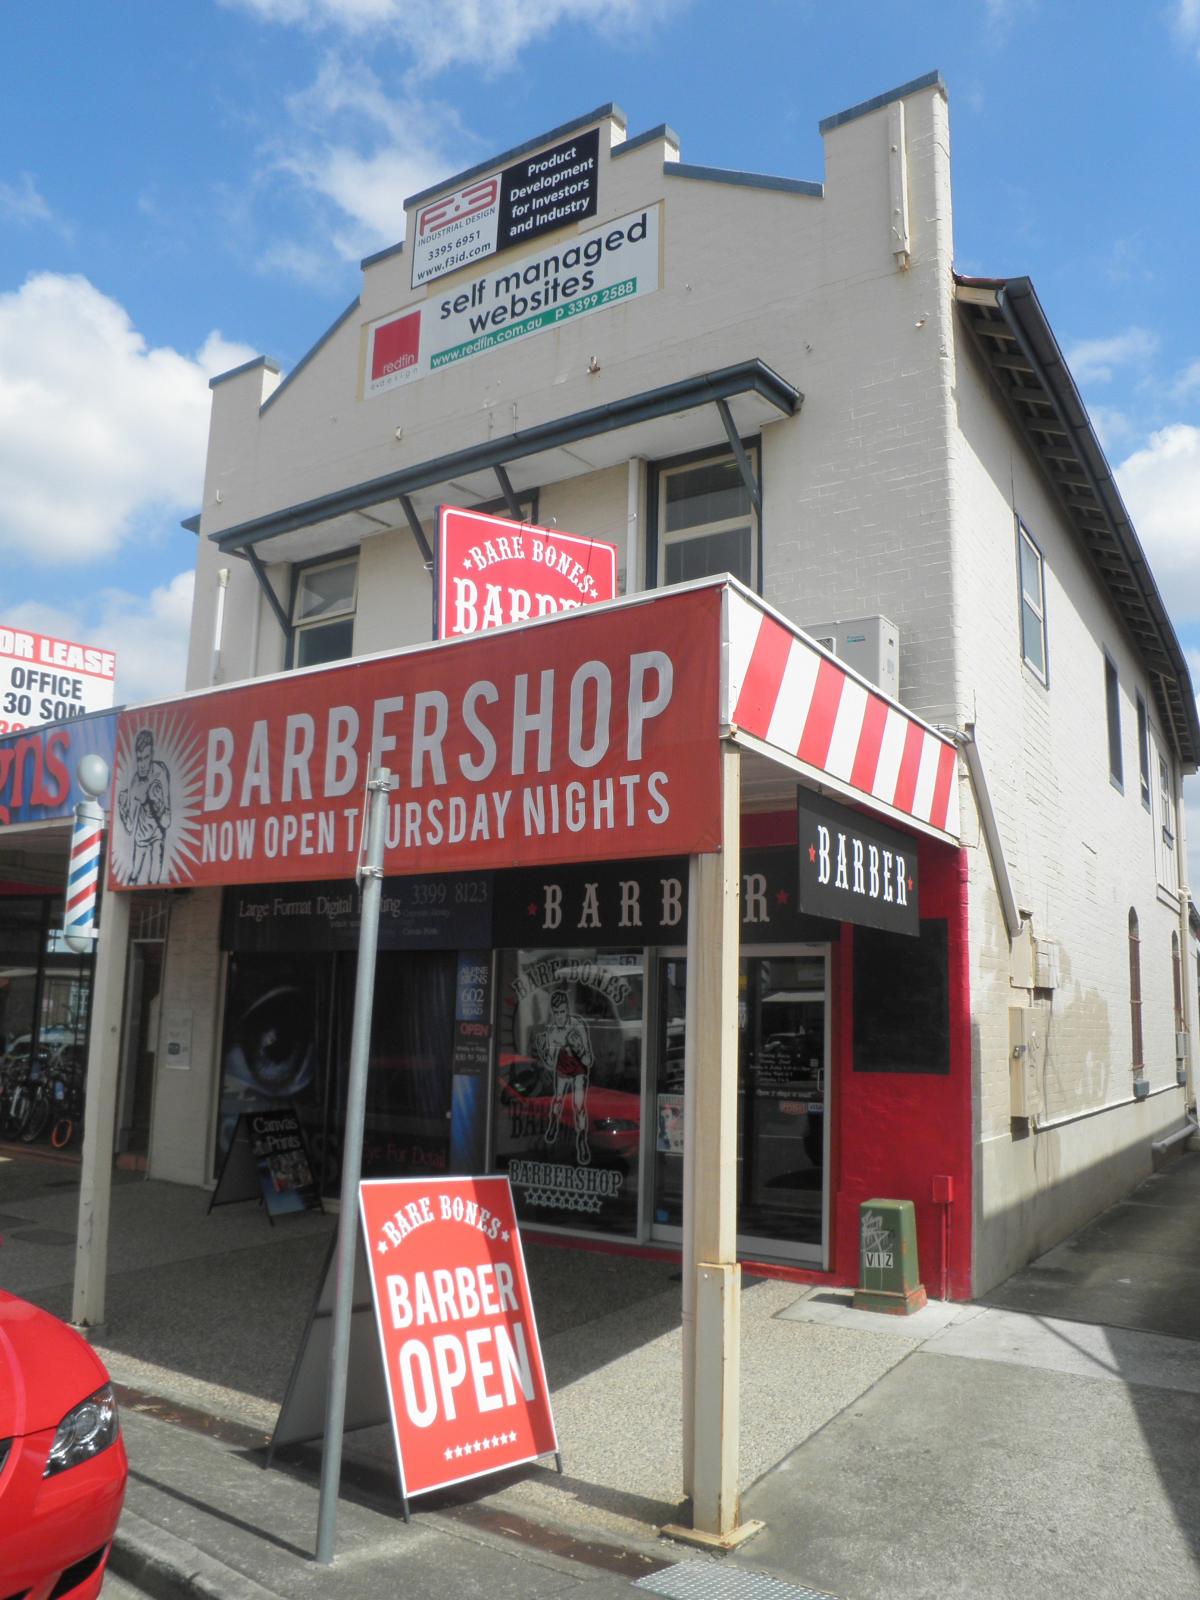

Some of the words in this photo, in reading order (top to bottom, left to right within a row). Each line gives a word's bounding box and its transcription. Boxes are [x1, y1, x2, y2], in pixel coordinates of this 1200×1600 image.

[510, 157, 594, 202] Development
[527, 147, 577, 177] Product
[509, 216, 533, 237] and
[536, 196, 591, 226] Industry
[512, 203, 530, 218] for
[532, 179, 590, 210] Investors
[417, 221, 463, 248] INDUSTRIAL
[465, 207, 496, 226] DESIGN
[428, 242, 453, 261] 3395
[455, 230, 481, 249] 6951
[417, 242, 491, 280] www.f3id.com
[440, 279, 487, 320] self
[495, 212, 648, 298] managed
[469, 269, 595, 334] websites
[432, 317, 542, 367] www.redfin.com.au
[568, 295, 598, 316] 3399
[602, 280, 634, 302] 2588
[383, 353, 416, 376] redfin
[468, 536, 526, 572] BARE
[531, 539, 596, 593] BONES
[452, 576, 591, 635] BAR
[0, 628, 34, 659] OR
[40, 638, 116, 677] LEASE
[3, 691, 32, 716] 30
[10, 666, 83, 700] OFFICE
[203, 651, 674, 812] BARBERSHOP
[202, 818, 256, 864] NOW
[264, 810, 335, 858] OPEN
[344, 790, 513, 852] TURSDAY
[522, 771, 670, 837] NIGHTS
[816, 824, 907, 906] BARBER
[239, 900, 270, 922] Large
[272, 897, 312, 917] Format
[316, 893, 353, 920] Digital
[411, 883, 447, 906] 3399
[454, 880, 488, 905] 8123
[541, 873, 770, 929] BARBR
[461, 988, 485, 1003] 602
[512, 958, 562, 1001] BARE
[568, 958, 632, 1006] BONES
[460, 1023, 489, 1037] OPEN
[508, 1159, 624, 1198] BARBERSHOP
[382, 1196, 435, 1248] BARE
[438, 1194, 503, 1241] BONES
[866, 1252, 893, 1268] VIZ
[386, 1262, 520, 1330] BARBER
[399, 1321, 536, 1429] OPEN
